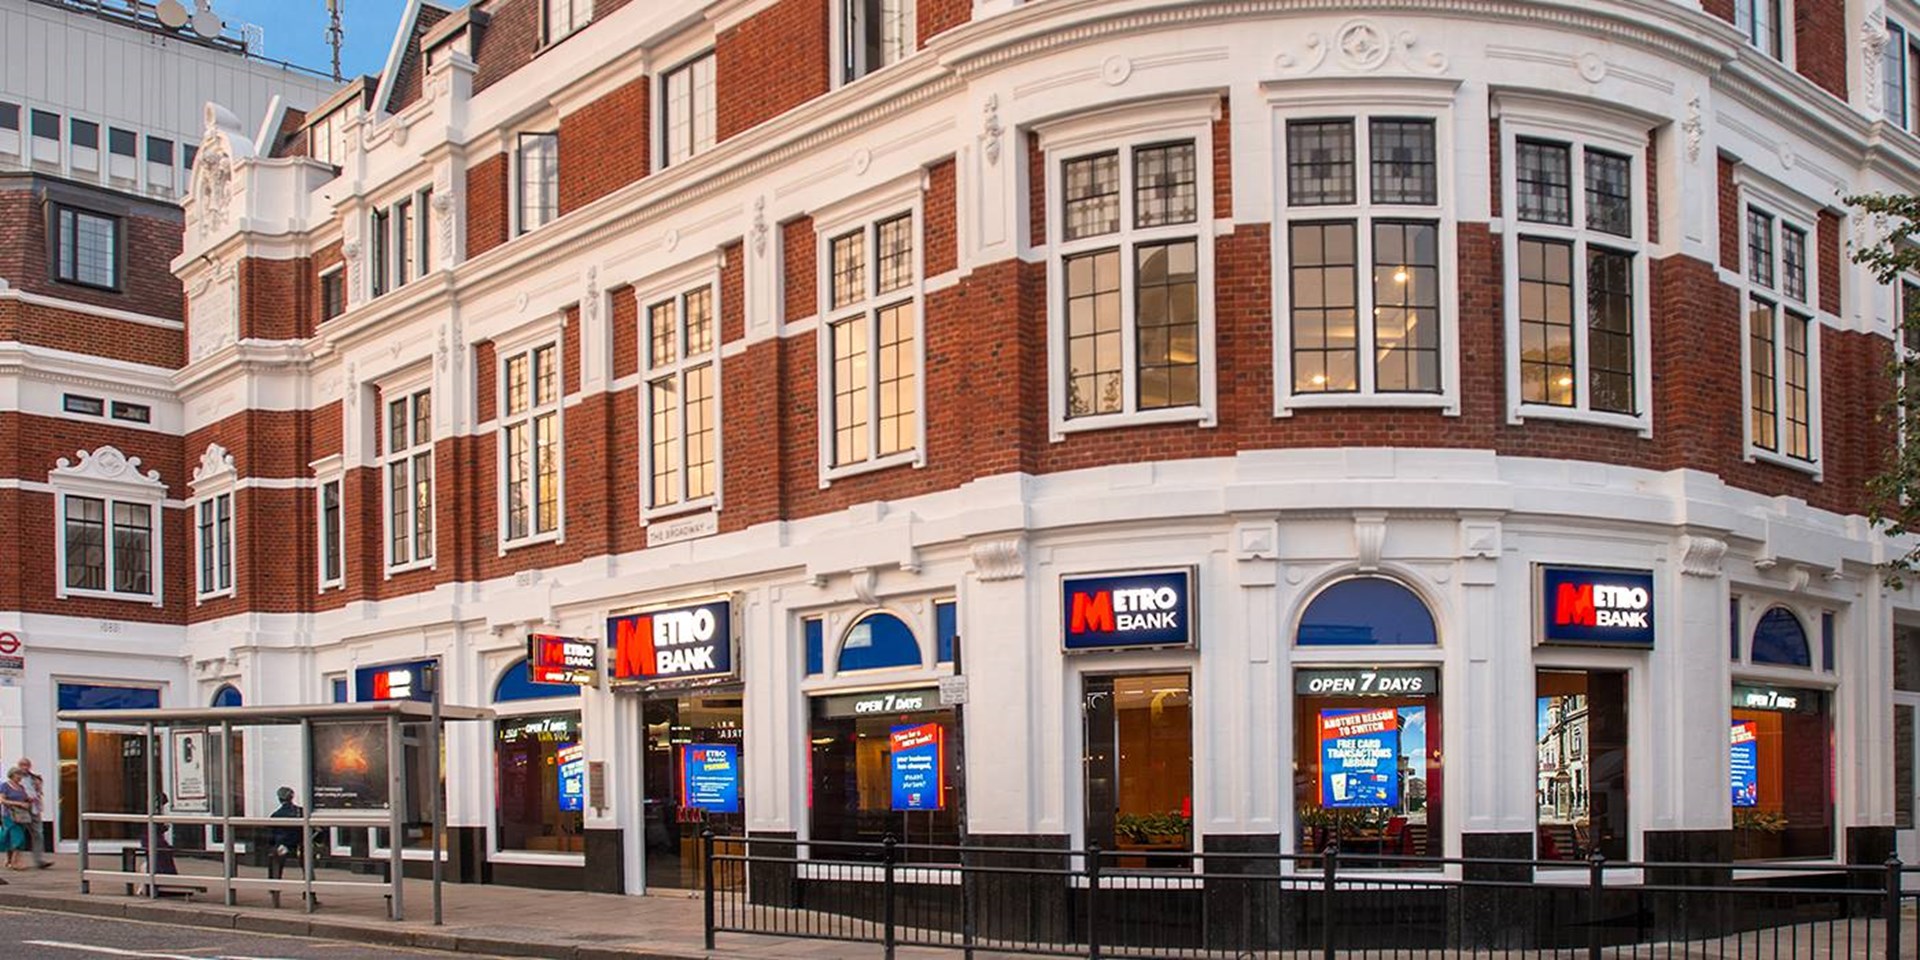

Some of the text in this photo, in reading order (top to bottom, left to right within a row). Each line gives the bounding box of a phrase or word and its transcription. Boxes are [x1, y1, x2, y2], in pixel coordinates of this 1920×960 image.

[1070, 586, 1177, 634] METRO
[1556, 583, 1648, 627] METRO
[1116, 612, 1177, 631] BANK
[1596, 610, 1648, 628] BANK
[615, 608, 715, 678] METRO
[545, 642, 594, 666] METRO
[565, 656, 593, 667] BANK
[656, 645, 715, 674] BANK
[564, 671, 573, 682] 7
[1309, 673, 1422, 691] OPEN 7 DAYS
[855, 695, 923, 712] OPEN 7 DAYS
[1768, 691, 1778, 707] 7
[541, 719, 551, 732] 7
[1324, 710, 1394, 729] ANOTHER REASON
[1339, 721, 1384, 736] TO SWITCH
[1336, 739, 1381, 749] FREE CARD
[1327, 748, 1392, 759] TRANSACTIONS
